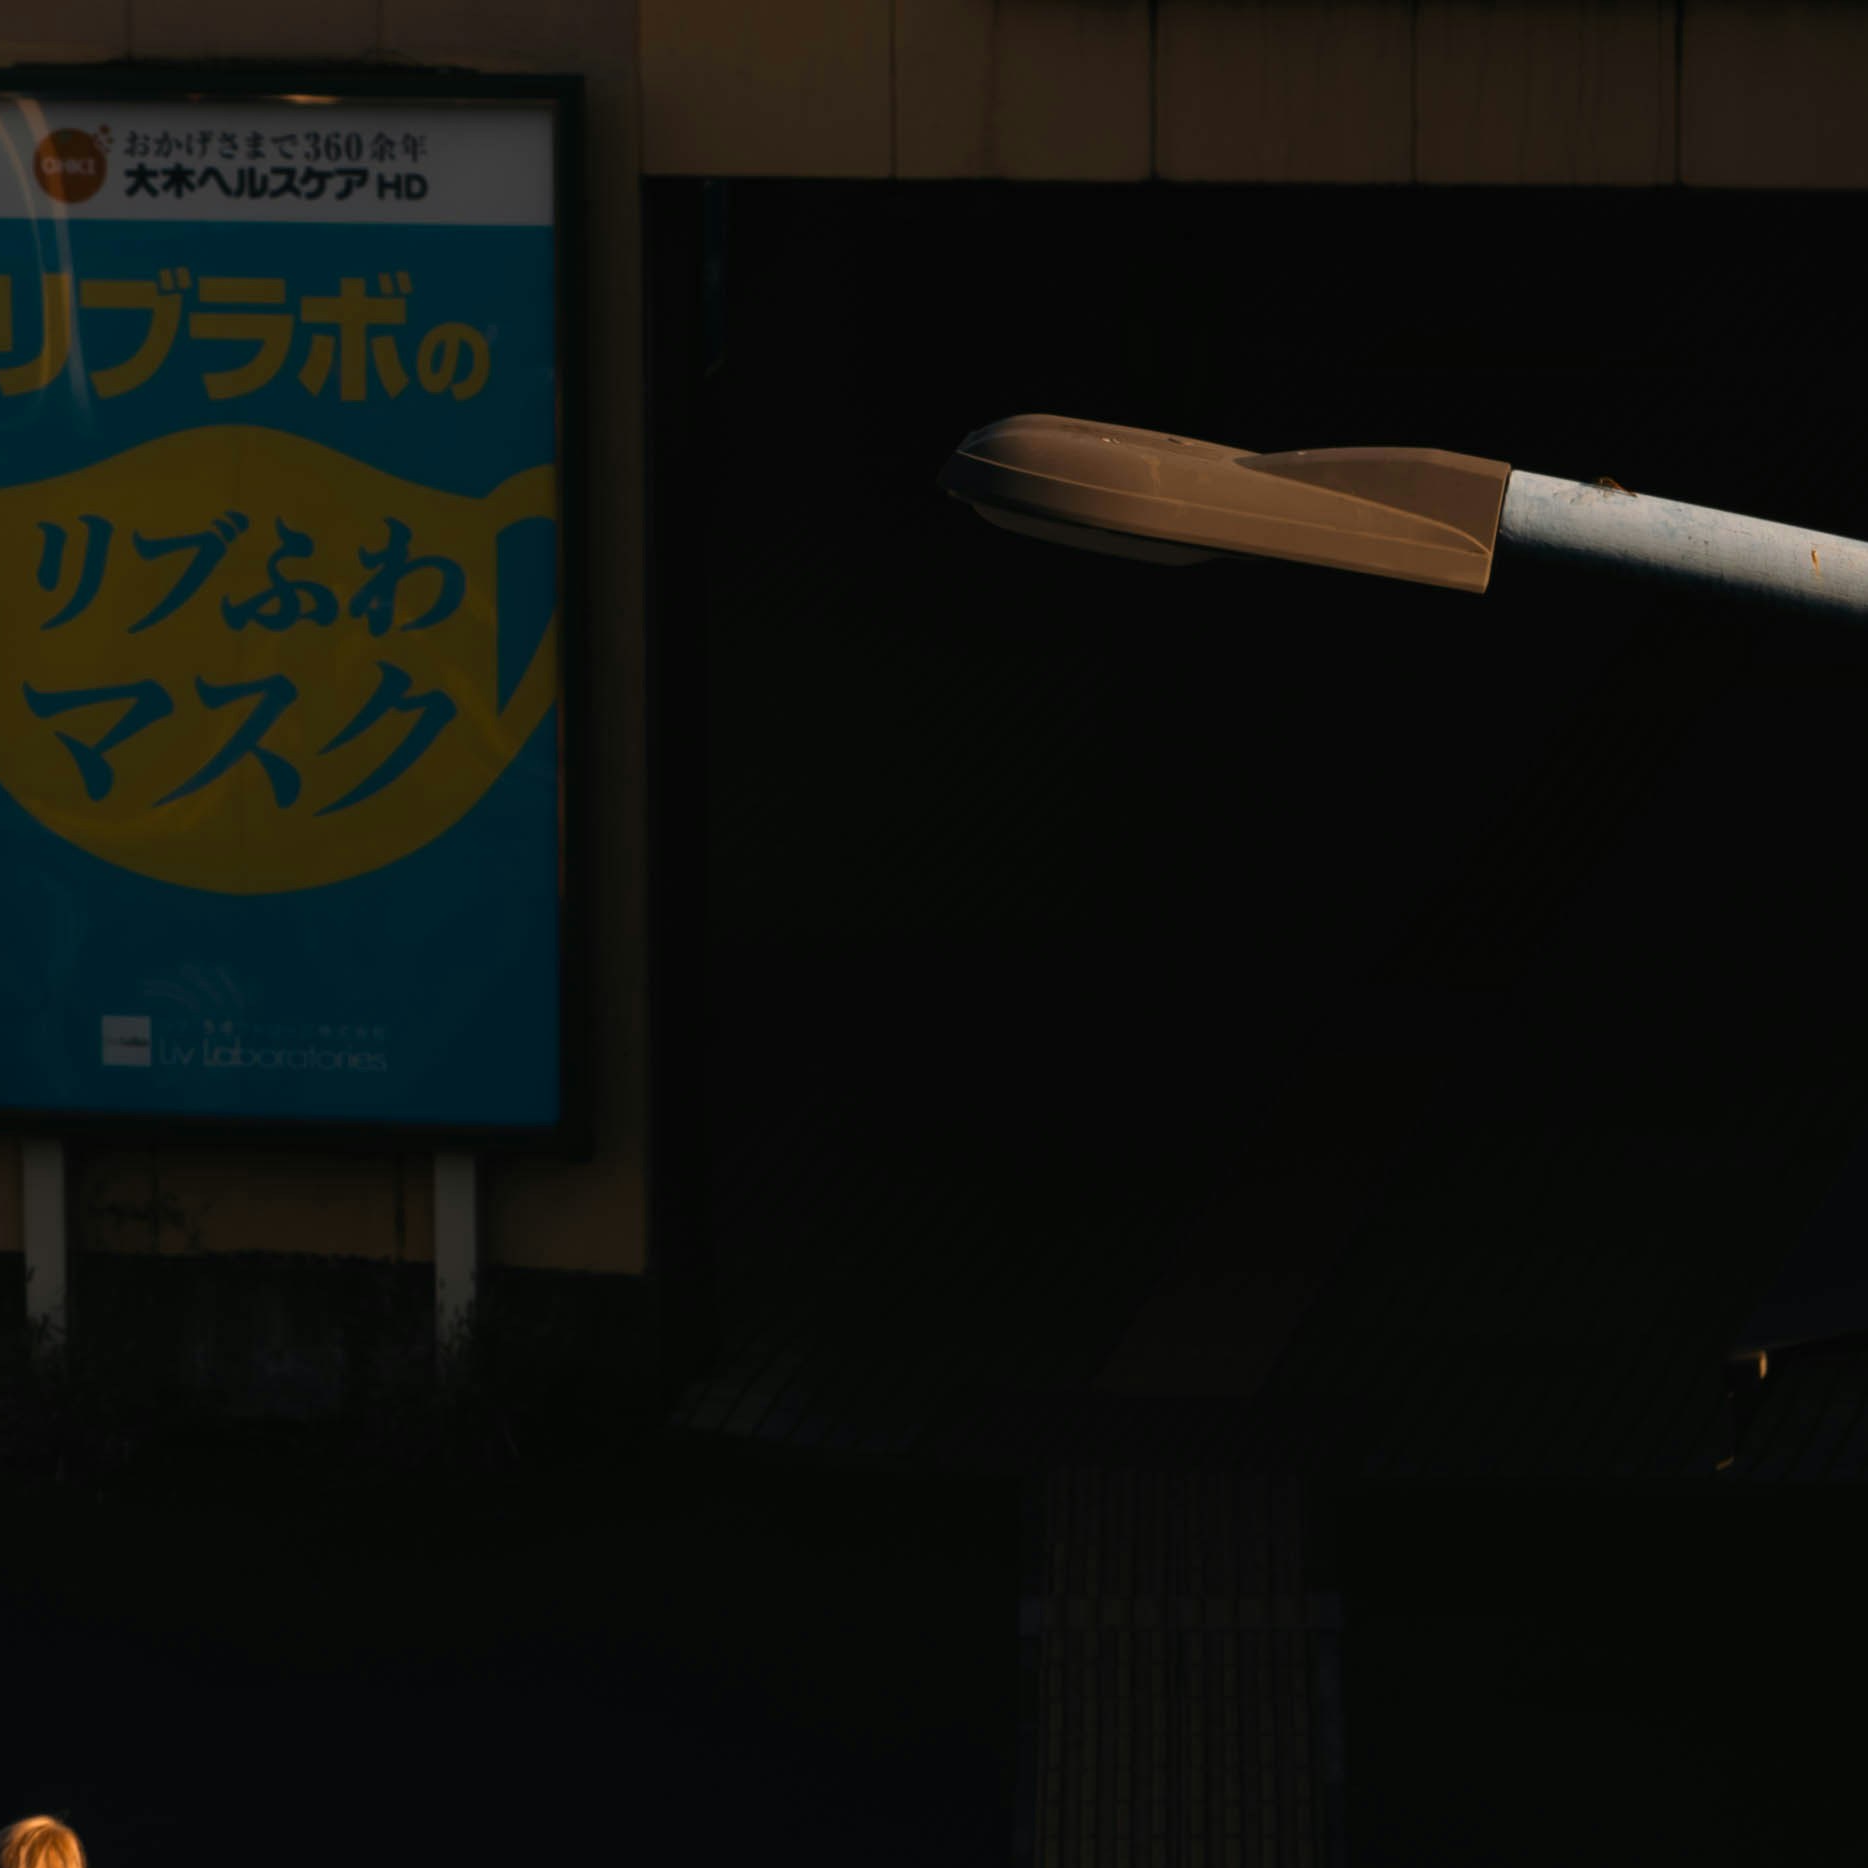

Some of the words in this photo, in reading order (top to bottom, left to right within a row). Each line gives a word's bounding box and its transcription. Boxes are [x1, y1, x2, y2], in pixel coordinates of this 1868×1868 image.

[125, 132, 428, 163] おかげさまで360余年
[38, 511, 465, 637] リブふわ
[23, 661, 456, 817] マスク
